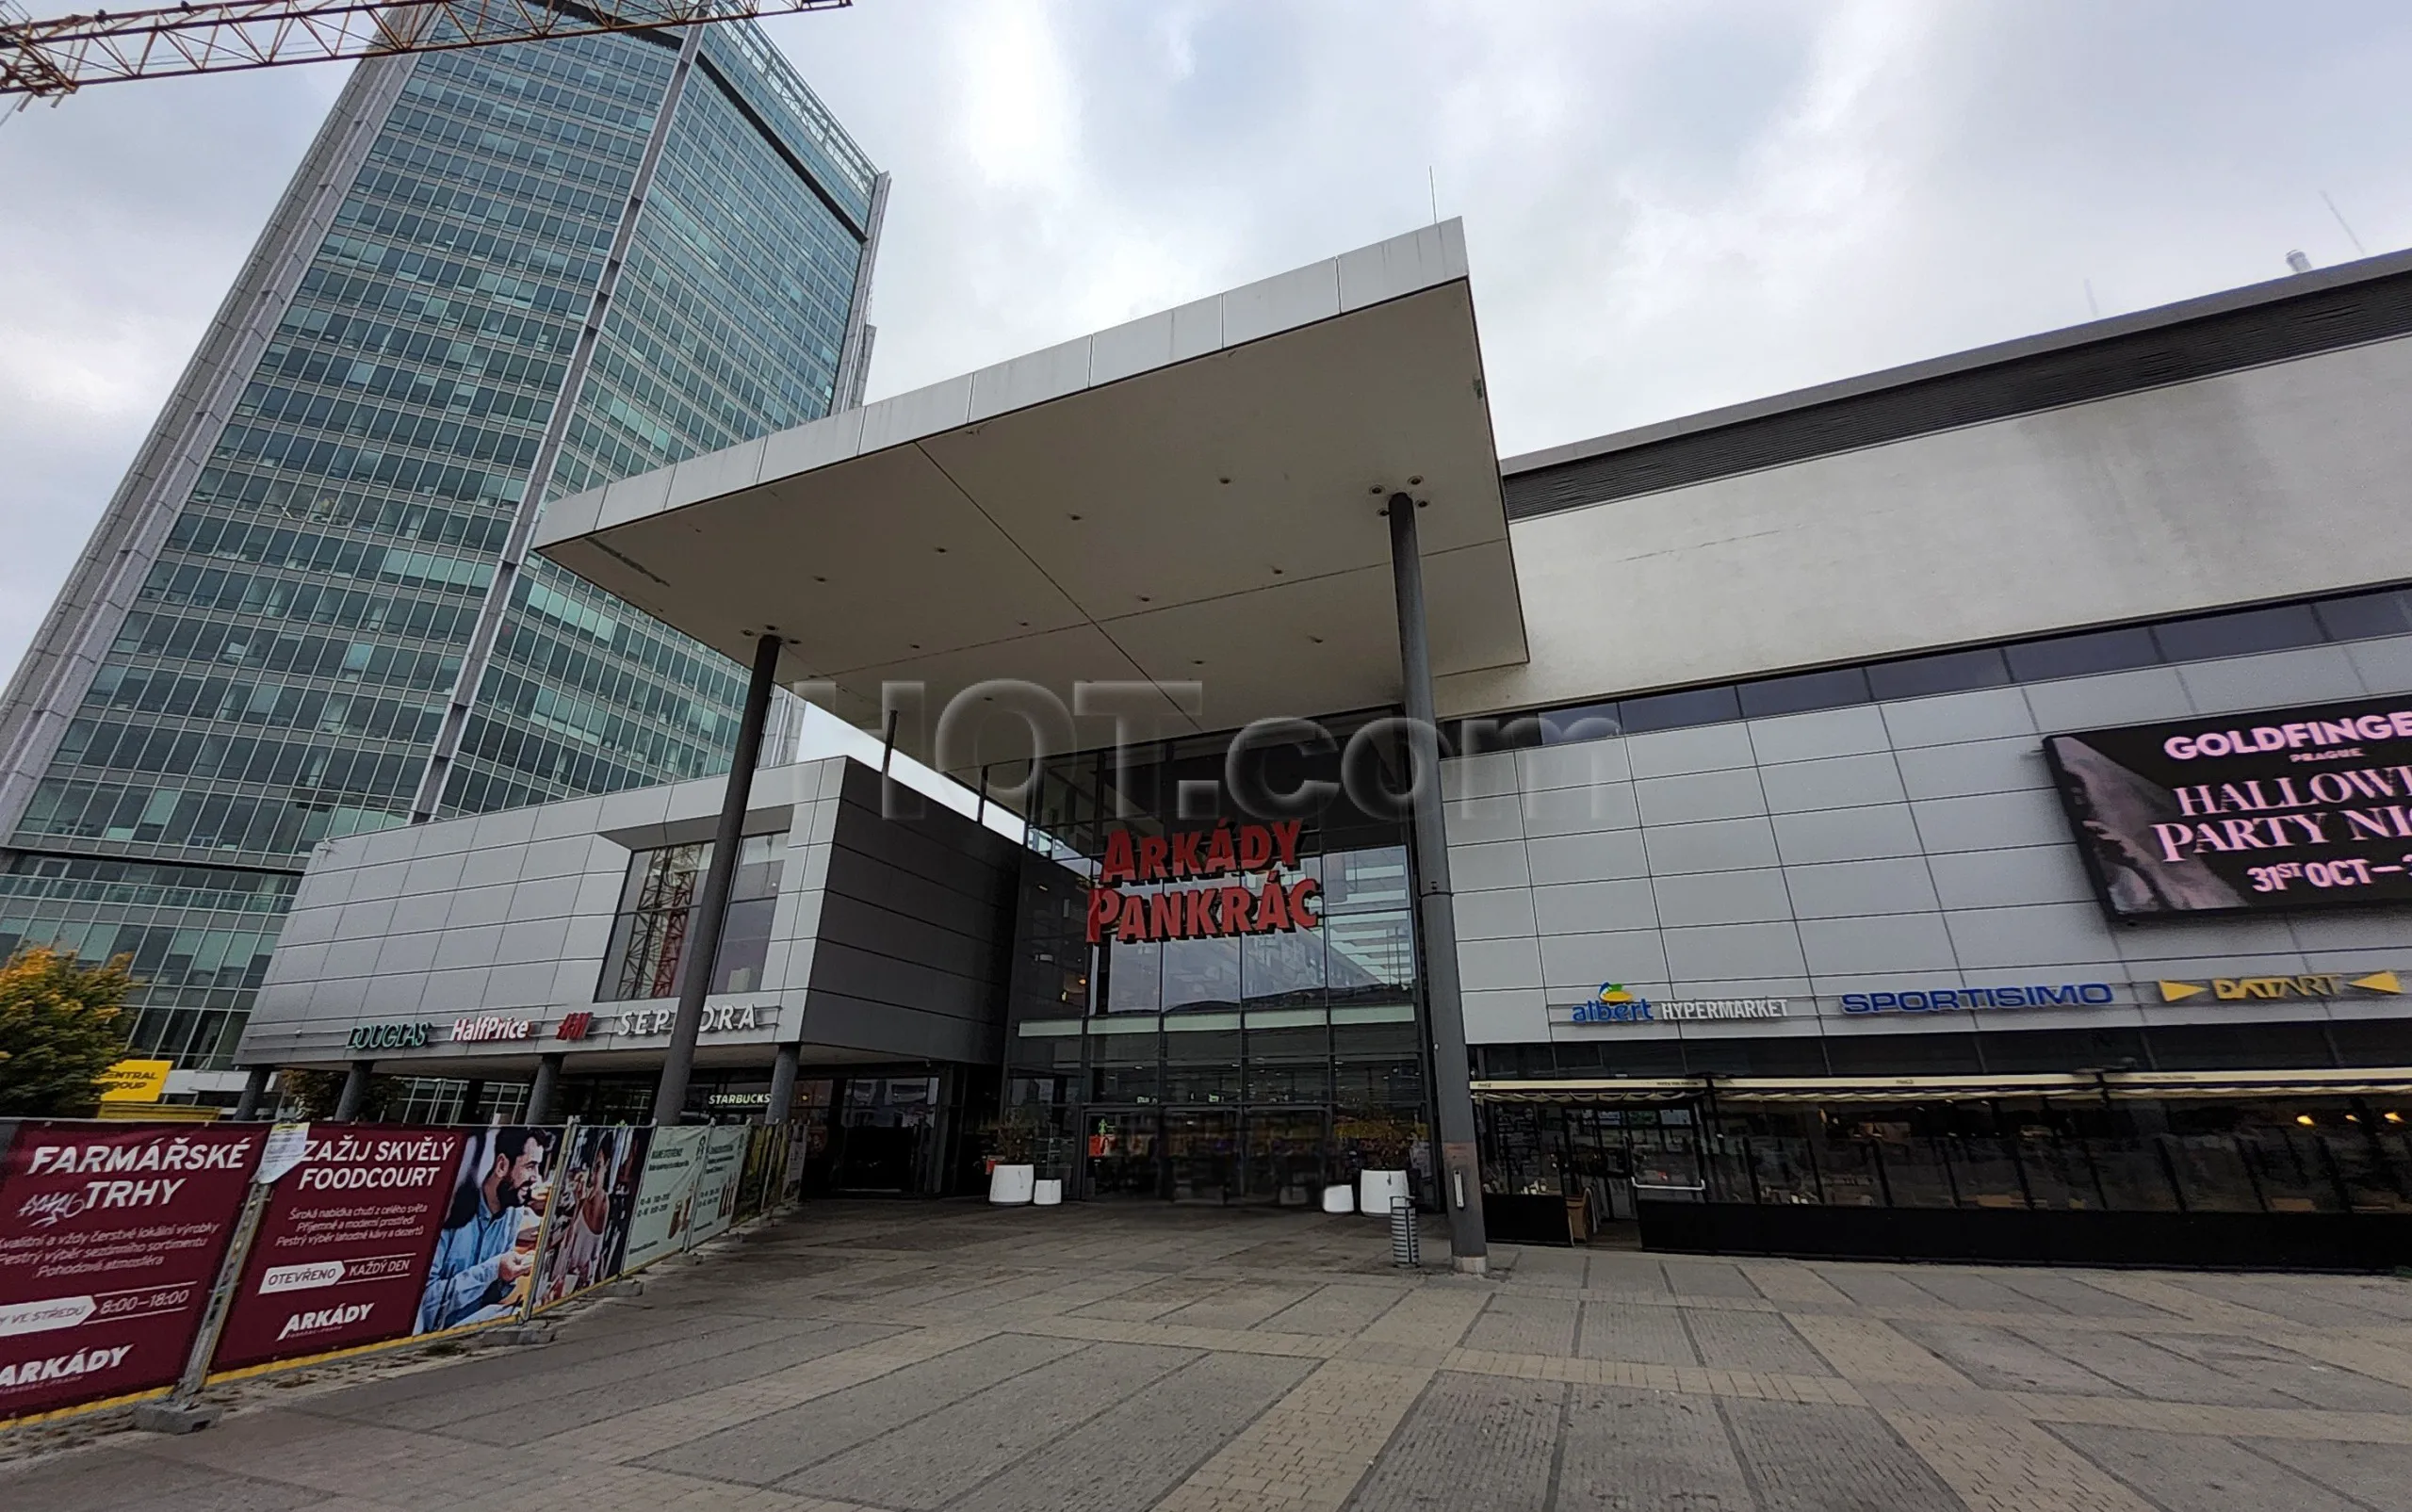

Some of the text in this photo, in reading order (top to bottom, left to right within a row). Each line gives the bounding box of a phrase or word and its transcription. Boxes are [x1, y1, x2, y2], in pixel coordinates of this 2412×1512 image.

[2149, 805, 2412, 862] PARTY NI
[1100, 818, 1303, 883] ARKÁDY
[1086, 870, 1318, 943] PANKRÁC
[1841, 983, 2114, 1016] SPORTISIMO
[2211, 974, 2342, 1000] DATART
[618, 1003, 755, 1036] SEPORA
[1573, 996, 1788, 1021] albert HYPERMARKET
[345, 1021, 430, 1049] DOUGLAS
[449, 1016, 529, 1042] HalfPrice
[101, 1071, 158, 1080] ENTRAL
[709, 1094, 773, 1105] STARBUCKS
[26, 1137, 252, 1175] FARMÁŘSKÉ
[301, 1134, 375, 1161] ZAŽIJ
[375, 1137, 455, 1161] SKVĚLÝ
[298, 1167, 440, 1190] FOODCOURT
[83, 1178, 187, 1210] TRHY
[268, 1268, 335, 1286] OTEVŘENO
[349, 1260, 411, 1276] KAŽDÝ DEN
[276, 1302, 375, 1341] ARKÁDY
[0, 1344, 135, 1388] ARKÁDY
